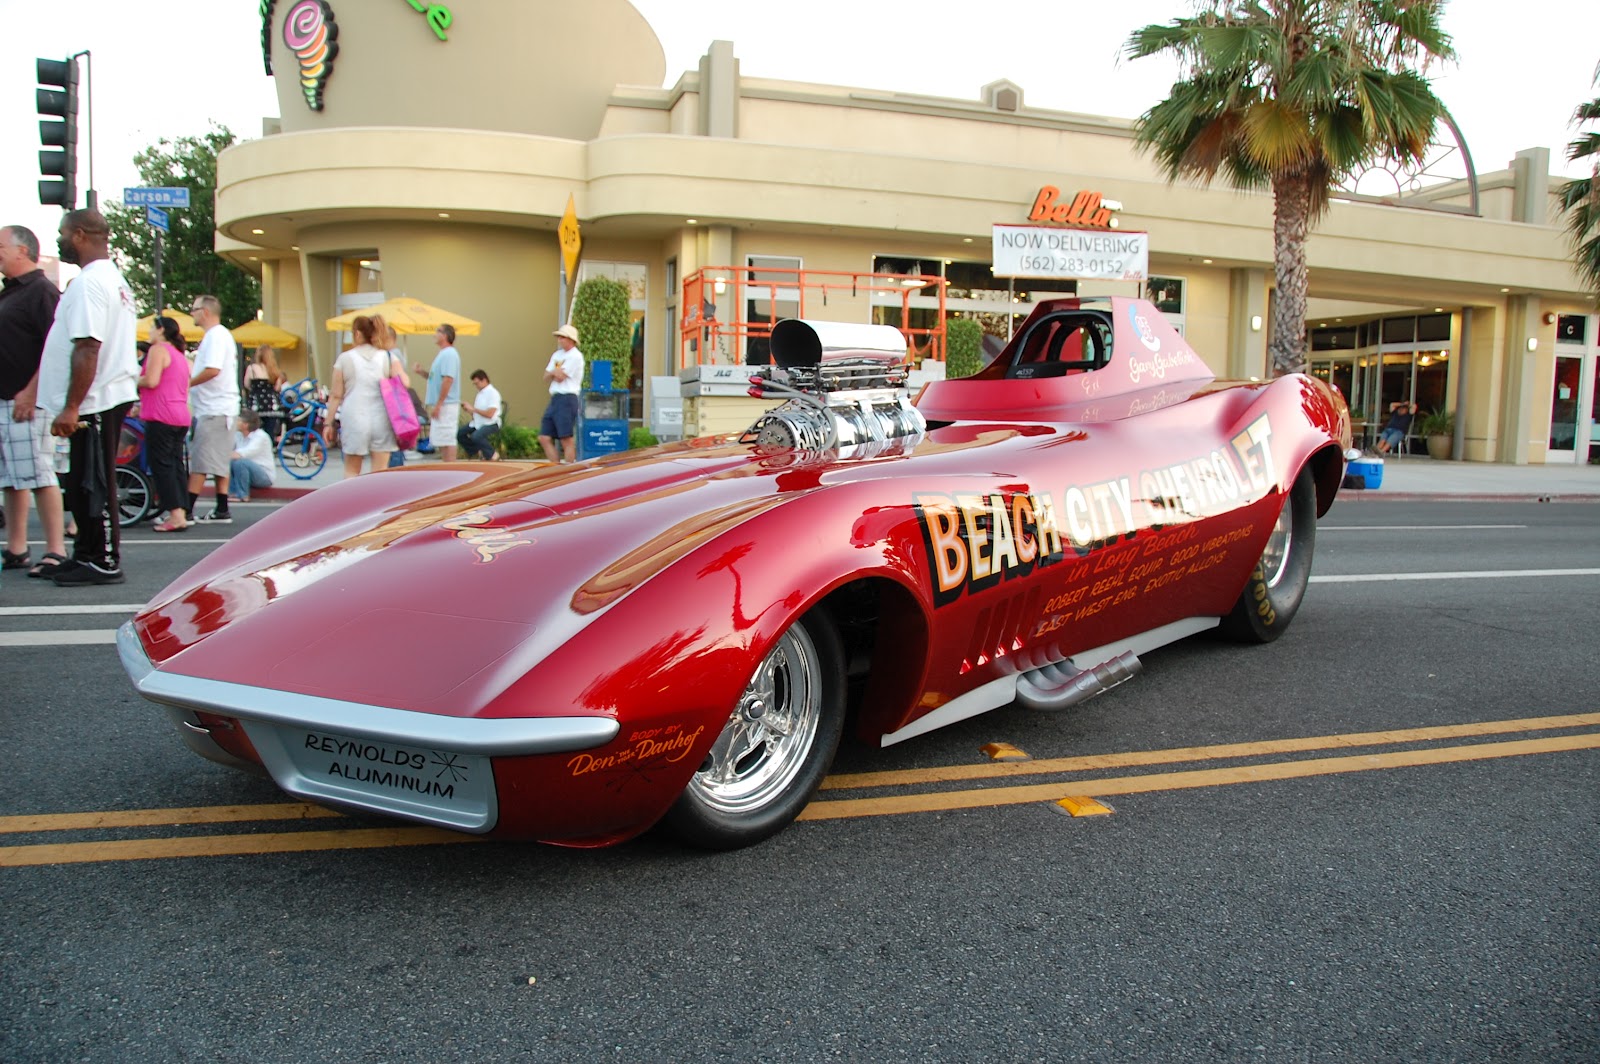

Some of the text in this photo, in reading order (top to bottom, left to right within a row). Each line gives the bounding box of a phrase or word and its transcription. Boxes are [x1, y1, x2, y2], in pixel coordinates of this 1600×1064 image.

[125, 189, 171, 202] Carson
[1027, 184, 1112, 228] Bella
[564, 225, 576, 248] DIP
[1001, 232, 1139, 254] NOW DELIVERING
[1020, 254, 1123, 274] (562) 283-0152
[1566, 324, 1574, 335] C
[714, 369, 733, 377] JLG
[1129, 356, 1156, 383] Gary
[914, 412, 1278, 602] BEACH CITY CHEVROLET
[1065, 522, 1199, 584] in Long Beach
[1043, 586, 1089, 615] ROBERT
[1170, 545, 1200, 566] GOOD
[1036, 612, 1073, 638] EAST
[1074, 596, 1113, 621] WEST
[1144, 568, 1185, 593] EXOTIC
[629, 724, 682, 742] BODY BY
[305, 734, 425, 769] REYNOLDS
[567, 753, 615, 776] Don
[636, 725, 704, 762] Danhof
[328, 762, 454, 799] ALUMINUM
